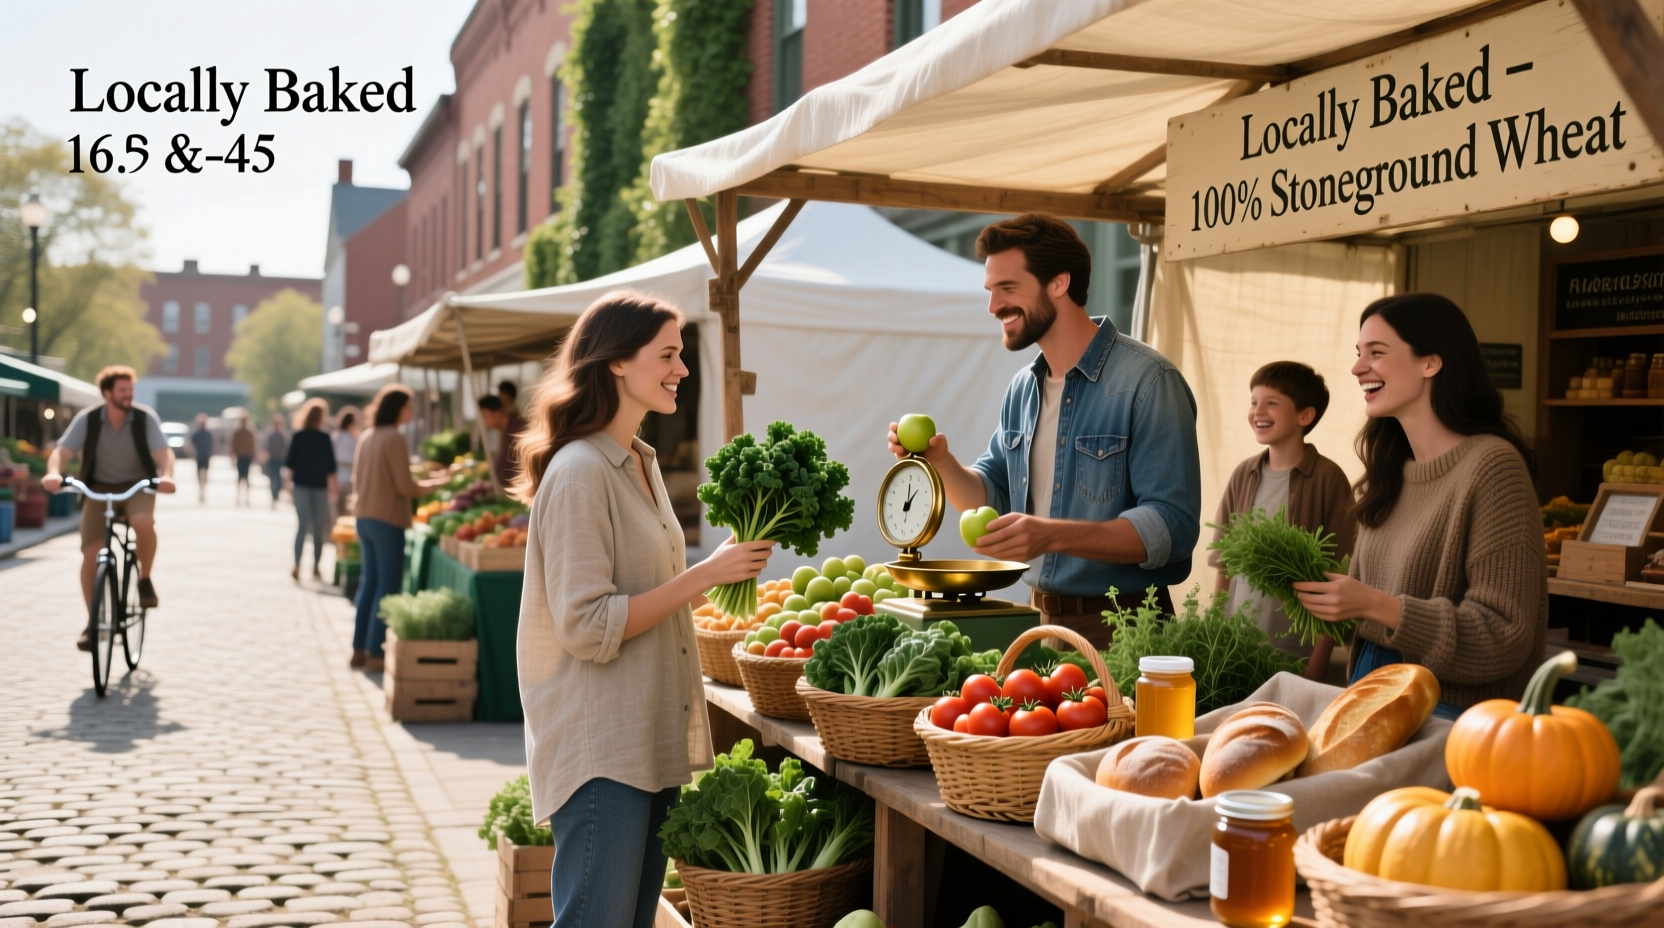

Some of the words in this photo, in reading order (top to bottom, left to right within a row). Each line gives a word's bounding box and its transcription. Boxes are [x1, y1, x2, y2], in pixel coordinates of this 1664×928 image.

[1240, 86, 1360, 161] Locally
[1369, 43, 1493, 129] Baked
[1190, 177, 1263, 232] 100%
[1270, 122, 1479, 217] Stoneground
[1487, 100, 1628, 174] Wheat
